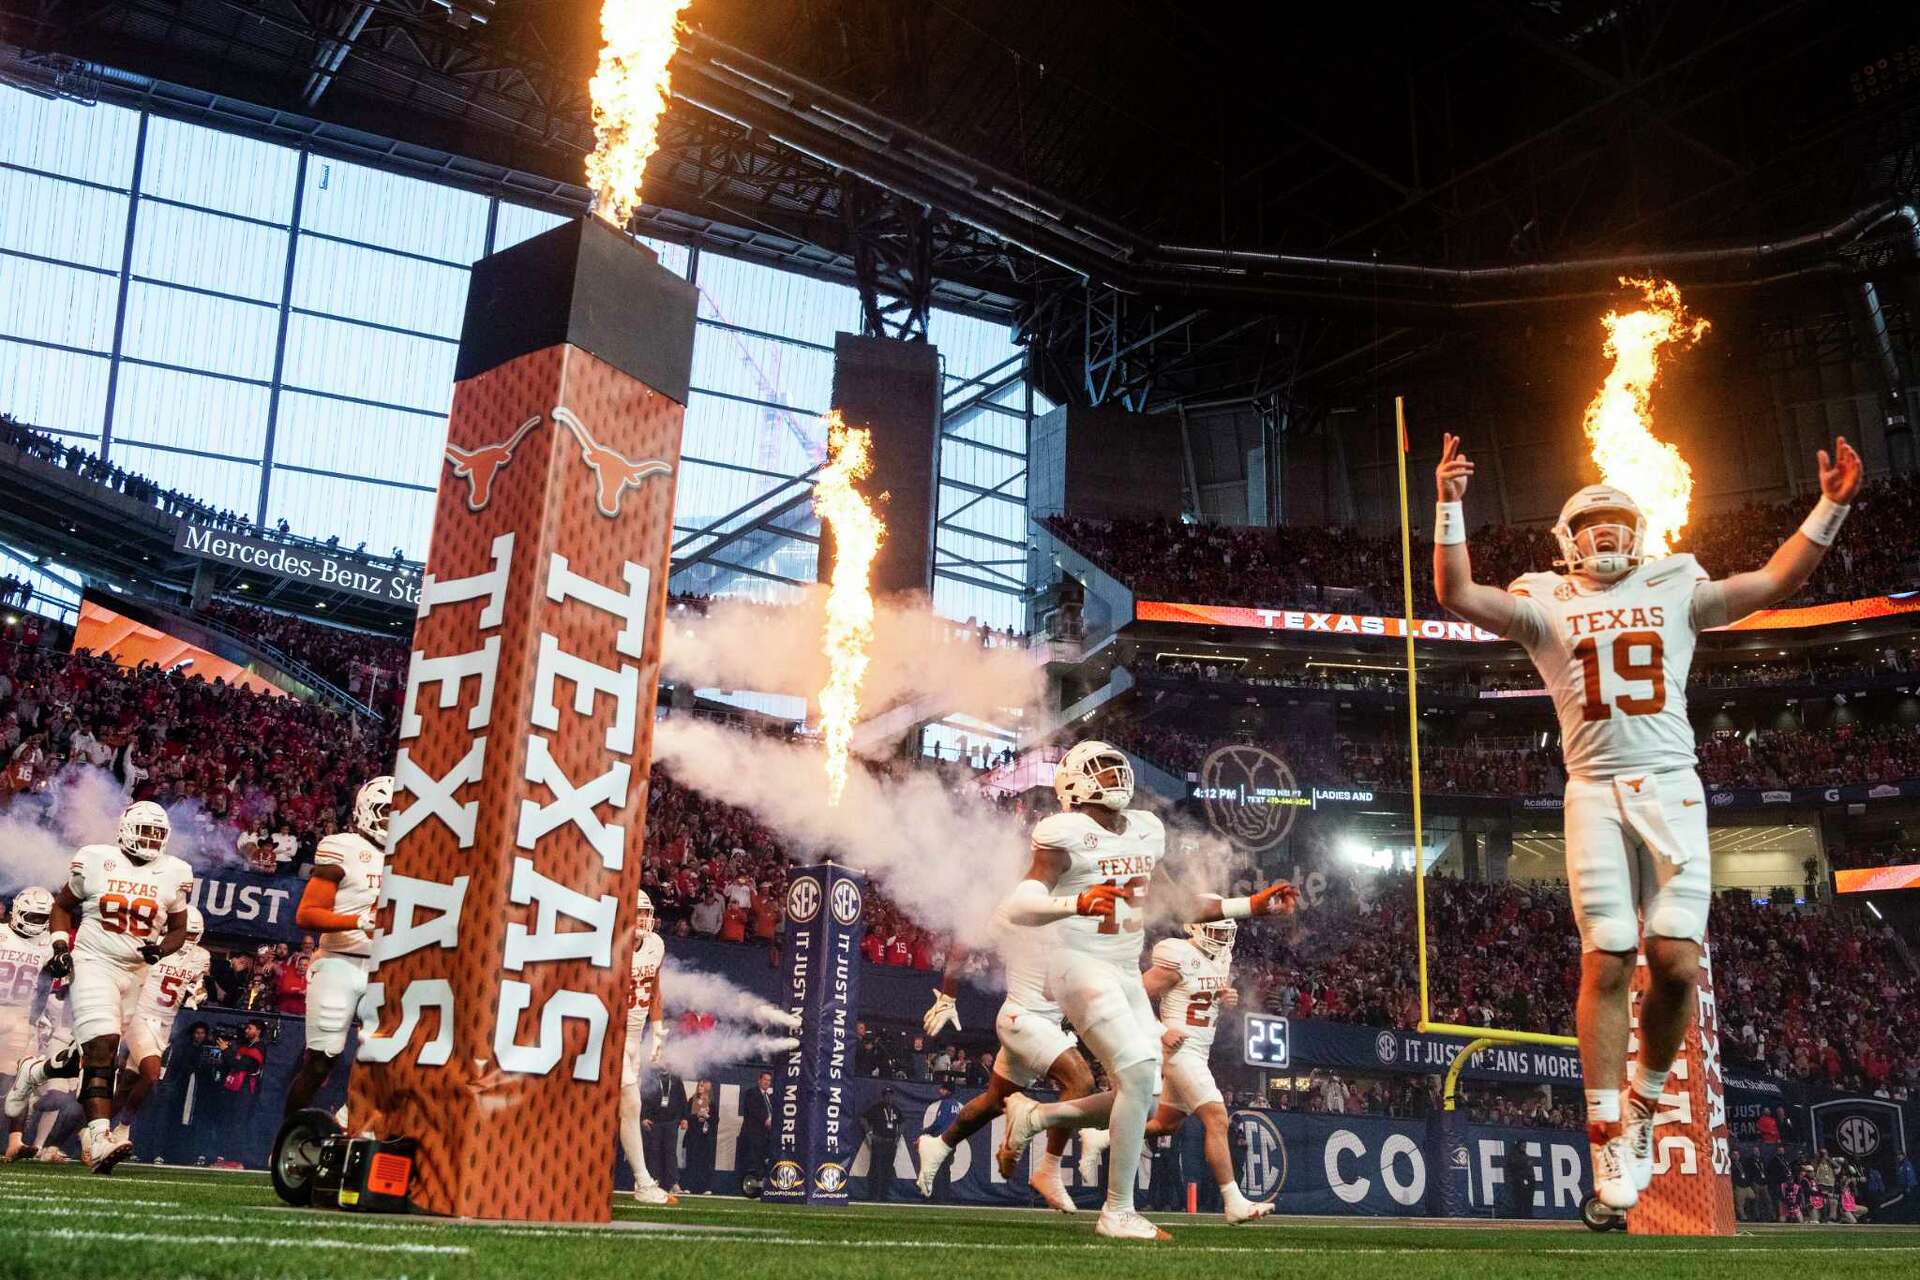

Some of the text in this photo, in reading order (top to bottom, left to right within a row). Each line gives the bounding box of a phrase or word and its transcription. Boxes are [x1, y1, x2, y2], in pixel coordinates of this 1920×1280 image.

[183, 526, 381, 595] Mercedes-Benz
[1256, 609, 1385, 634] TEXAS
[1567, 606, 1665, 635] TEXAS
[1573, 631, 1666, 722] 19
[358, 532, 515, 1066] TEXAS
[1193, 787, 1236, 800] 4:12 PM
[1316, 790, 1373, 802] LADIES AND
[494, 551, 650, 1081] TEXAS
[1098, 855, 1153, 876] TEXAS
[107, 879, 158, 898] TEXAS
[790, 881, 818, 919] SEC
[834, 883, 858, 921] SEC
[99, 894, 159, 937] 98
[0, 949, 41, 965] TEXAS
[796, 931, 810, 950] IT
[838, 933, 850, 953] IT
[159, 963, 193, 980] TEXAS
[793, 952, 808, 1000] JUST
[834, 954, 849, 1004] JUST
[157, 976, 183, 1008] 5
[1186, 991, 1219, 1028] 2
[787, 1006, 804, 1078] MENS
[829, 1008, 847, 1080] MEANS
[1249, 1020, 1286, 1061] 25
[1379, 1037, 1396, 1060] SEC
[1405, 1039, 1422, 1062] IT
[1838, 1117, 1877, 1154] SEC
[1240, 1120, 1279, 1197] EC
[1324, 1129, 1585, 1206] COFER
